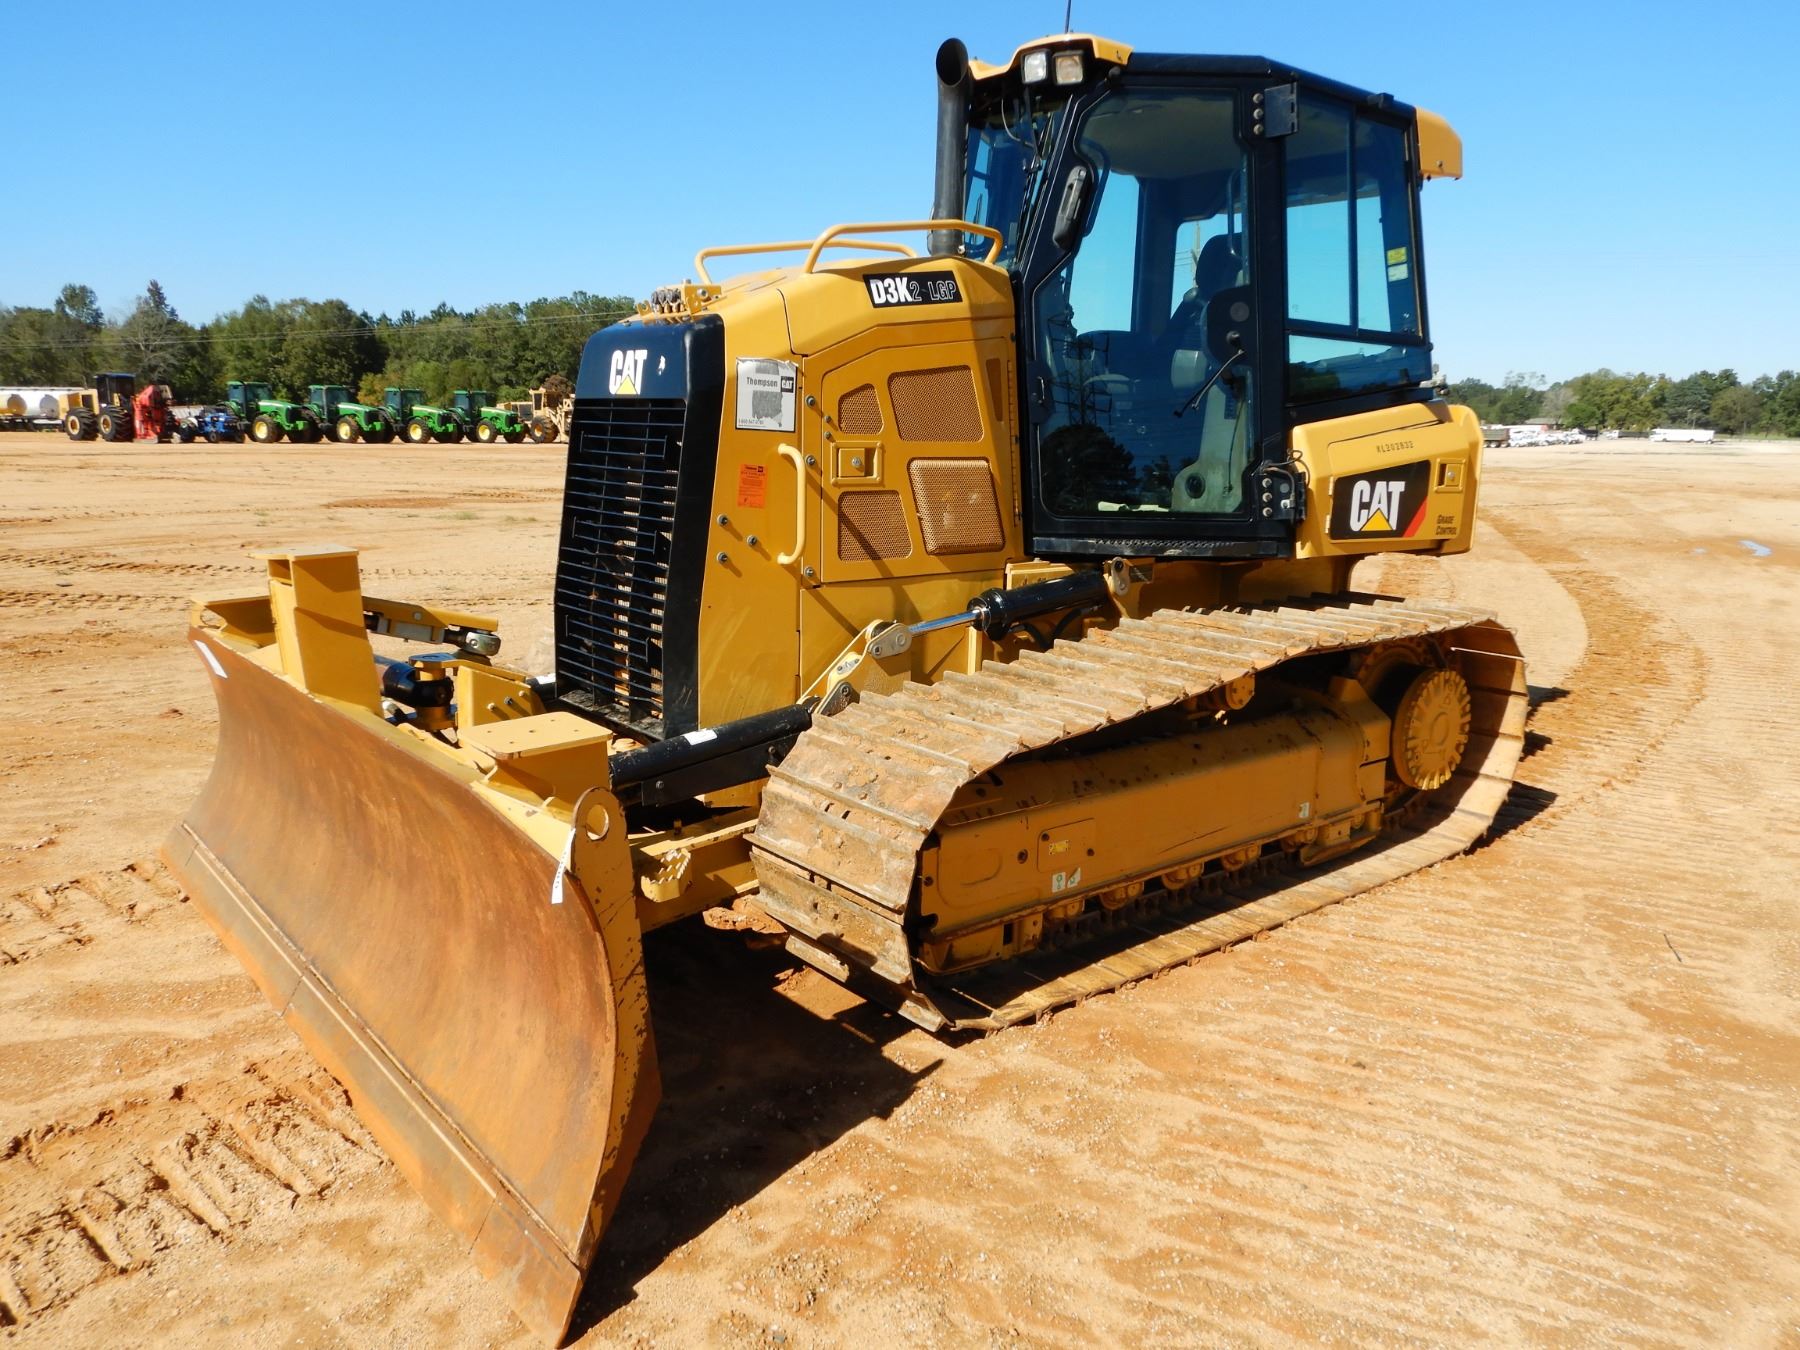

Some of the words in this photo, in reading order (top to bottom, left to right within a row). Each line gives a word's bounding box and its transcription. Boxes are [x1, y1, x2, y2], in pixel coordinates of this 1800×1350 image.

[869, 276, 922, 305] D3K2
[927, 280, 957, 301] LGP
[609, 349, 648, 395] CAT
[746, 376, 779, 388] Thompson
[1350, 479, 1406, 532] CAT
